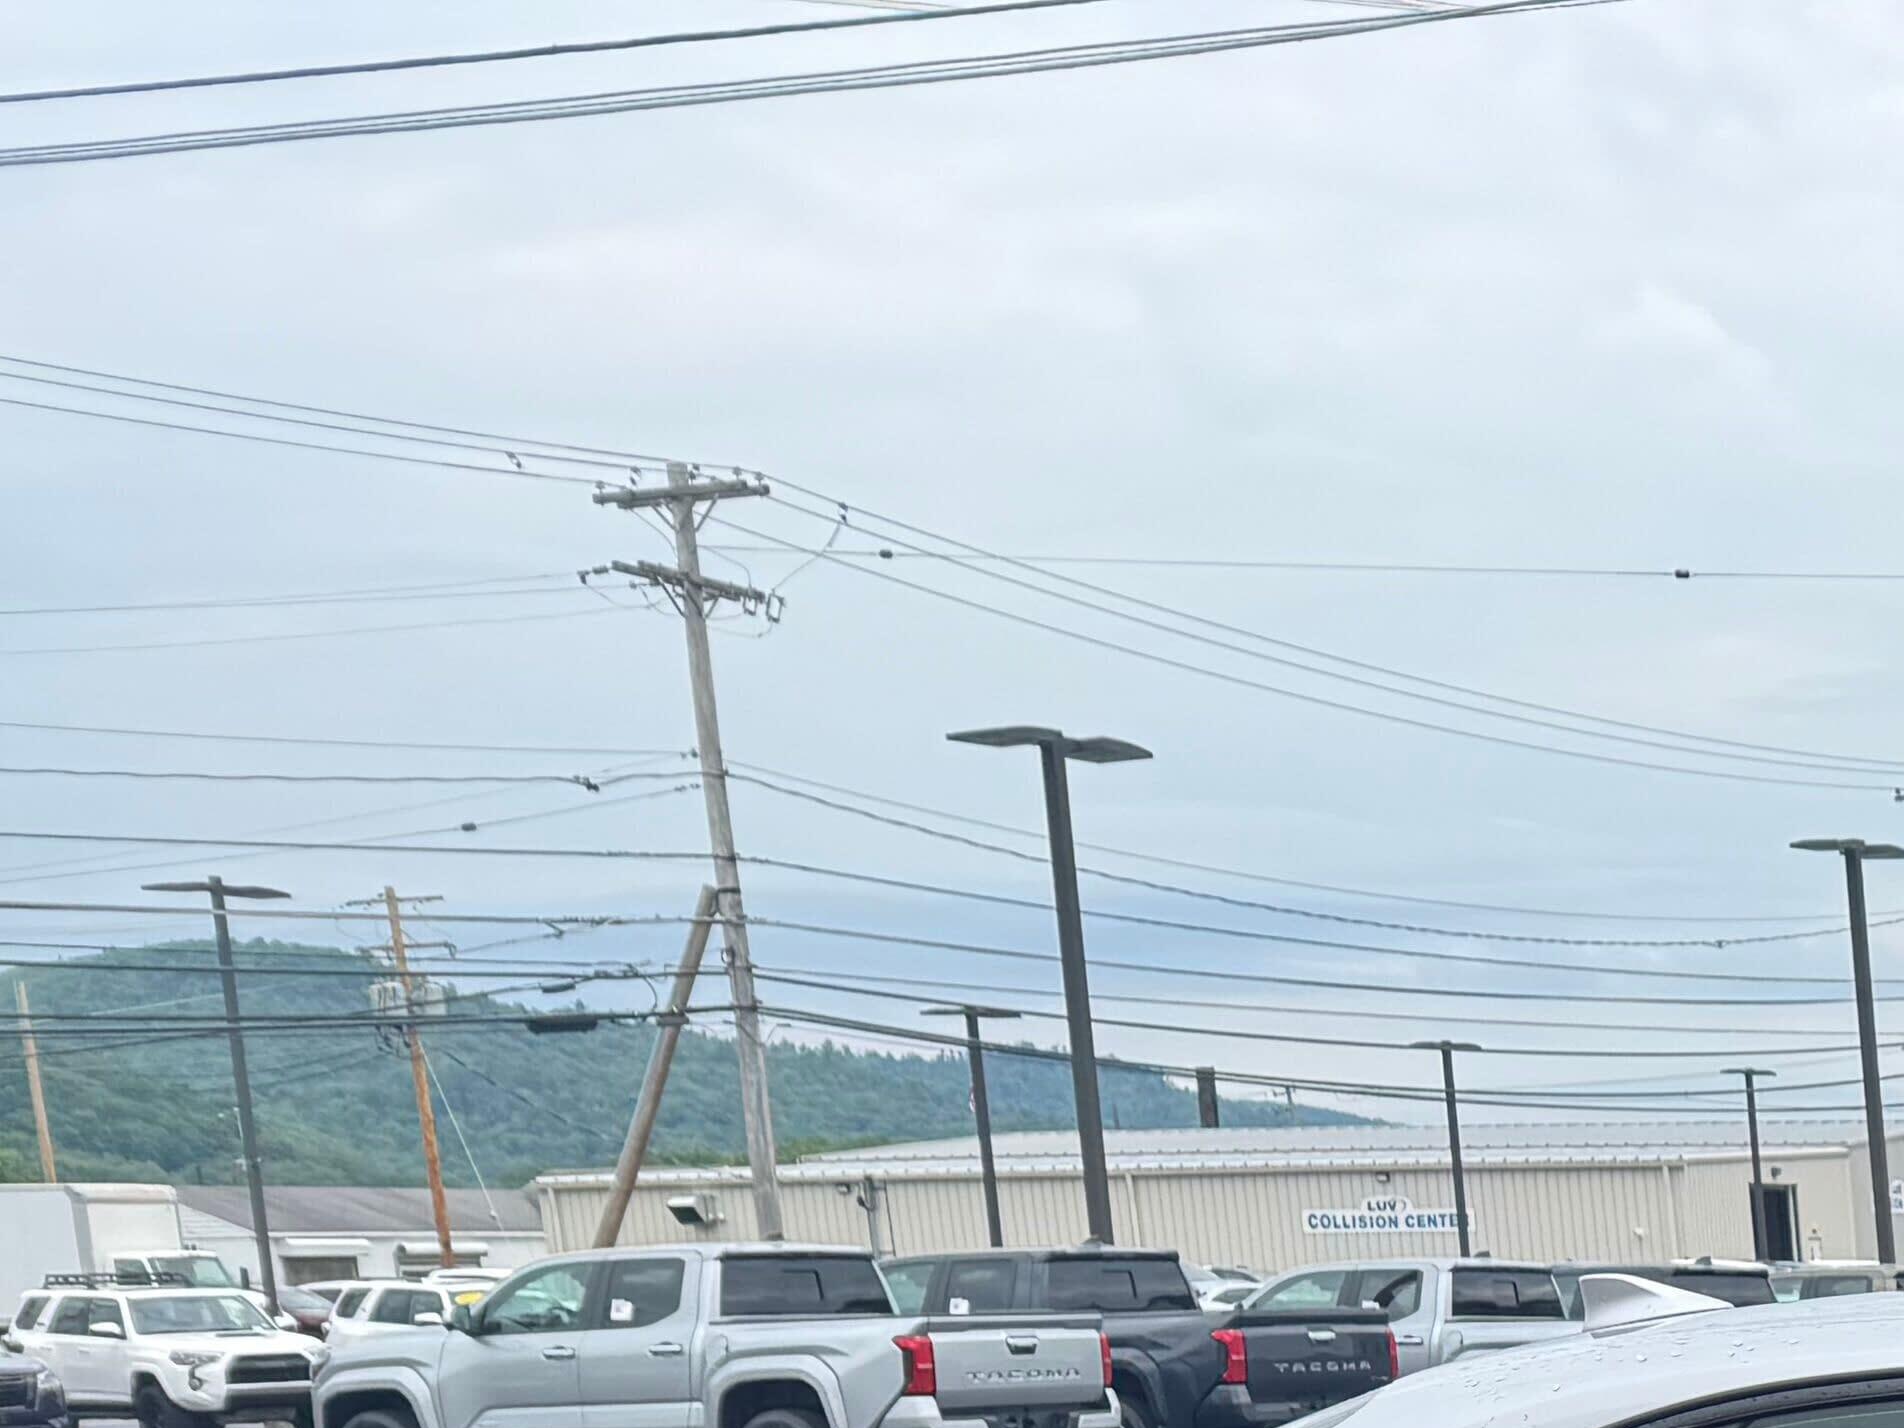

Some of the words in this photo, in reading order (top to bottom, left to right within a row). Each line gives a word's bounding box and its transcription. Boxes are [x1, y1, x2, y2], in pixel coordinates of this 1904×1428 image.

[1308, 1214, 1398, 1229] COLLISION
[1275, 1360, 1372, 1373] TACOMA
[966, 1367, 1080, 1381] TACOMA
